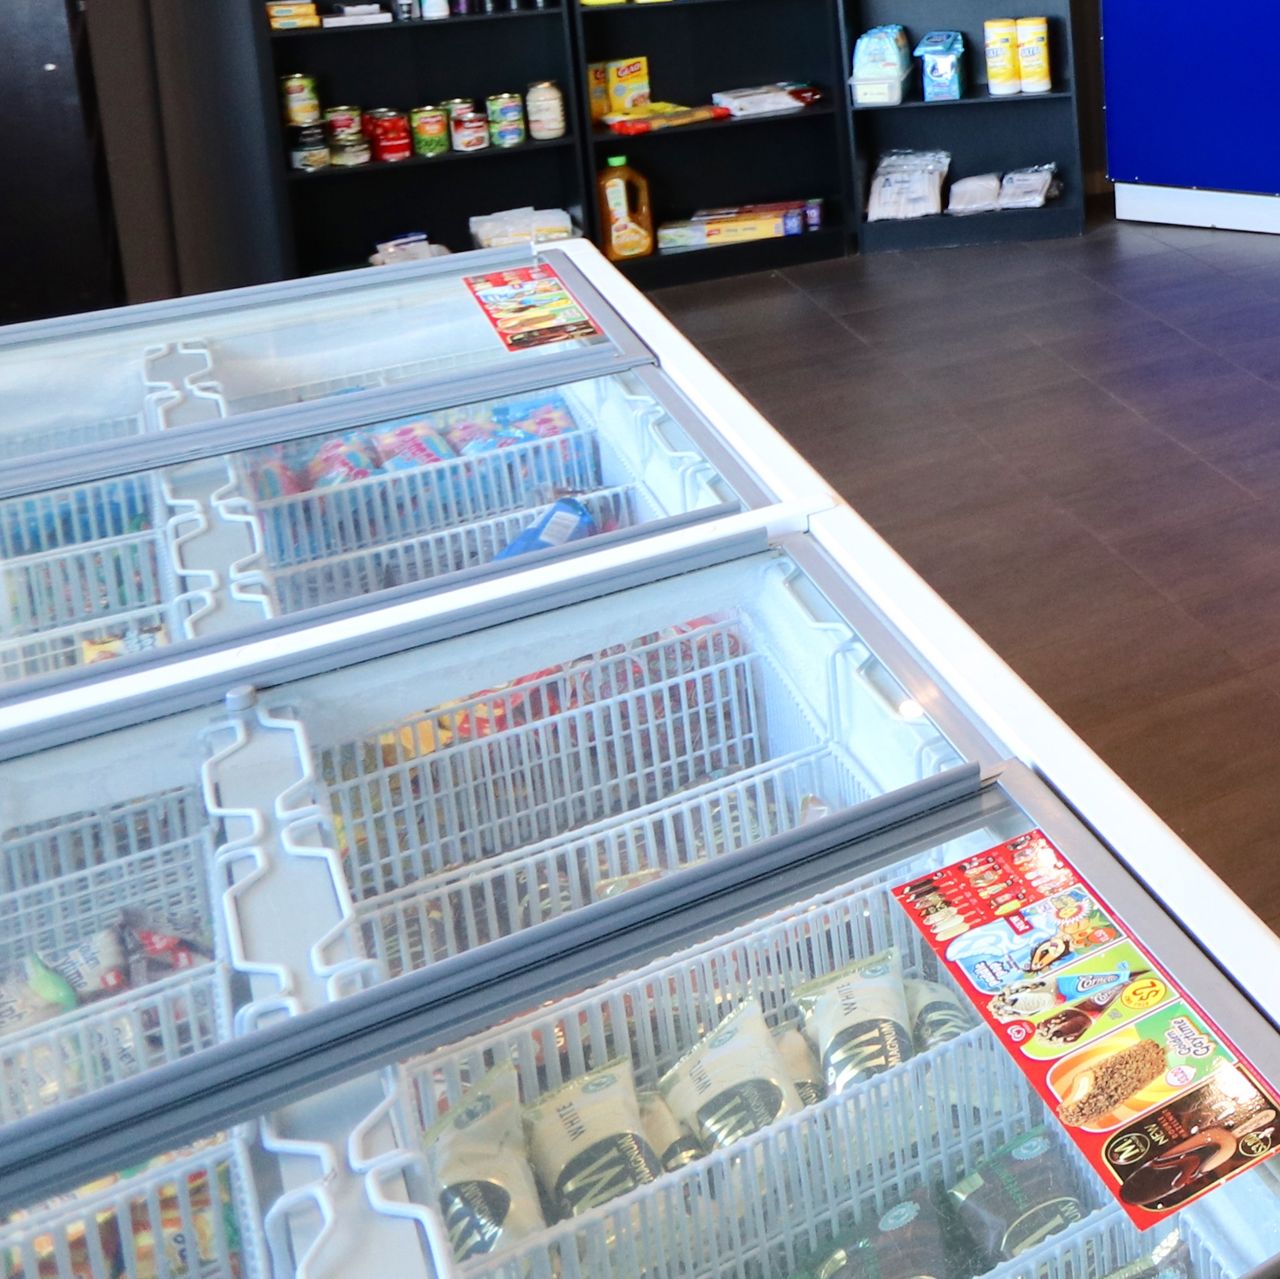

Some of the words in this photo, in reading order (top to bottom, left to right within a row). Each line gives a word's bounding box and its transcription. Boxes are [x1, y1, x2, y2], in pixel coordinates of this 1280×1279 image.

[836, 983, 857, 1016] WHITE
[880, 1020, 901, 1067] MAGNUM
[1165, 1029, 1192, 1056] Golden
[1173, 1019, 1210, 1057] Gaytime
[555, 1101, 585, 1142] WHITE
[1144, 1123, 1169, 1147] NEW
[617, 1134, 656, 1183] MAGNUM
